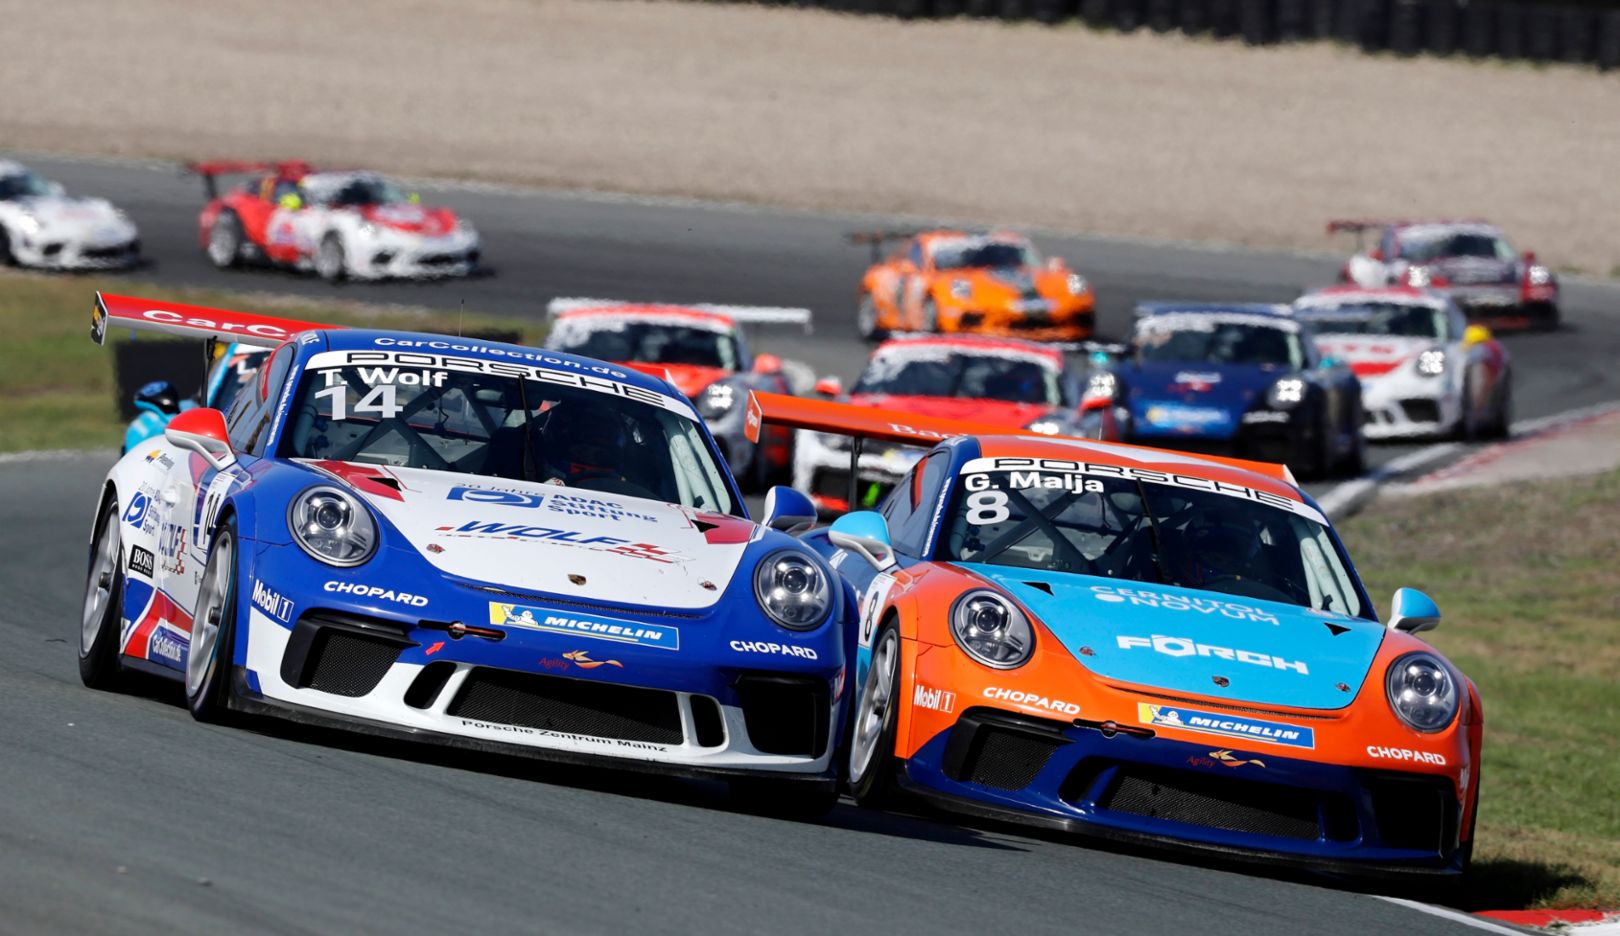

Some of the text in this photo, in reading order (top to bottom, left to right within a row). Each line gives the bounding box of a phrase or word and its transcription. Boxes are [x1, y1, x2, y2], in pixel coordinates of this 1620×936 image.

[143, 310, 296, 338] CarC
[374, 337, 627, 378] CarCollection.de
[316, 367, 448, 387] T. Wolf
[346, 351, 666, 406] PORSCHE
[314, 385, 403, 421] 14
[964, 471, 1104, 494] G. Malja
[994, 458, 1296, 510] PORSCHE
[547, 505, 621, 522] Sport
[550, 499, 659, 523] Stiftung
[553, 494, 623, 509] ADAC
[965, 490, 1009, 525] 8
[457, 520, 630, 545] WOLF
[132, 547, 153, 571] BOSS
[251, 579, 280, 616] Mobil
[323, 580, 429, 607] CHOPARD
[1090, 585, 1274, 617] CERNITOL
[864, 591, 880, 642] 8
[1129, 594, 1280, 626] NOVUM
[544, 615, 663, 641] MICHELIN
[730, 640, 818, 661] CHOPARD
[913, 683, 941, 711] Mobil
[983, 687, 1080, 715] CHOPARD
[462, 719, 668, 753] Porsche Zentrum Mainz
[1189, 716, 1300, 740] MICHELIN
[1367, 745, 1446, 766] CHOPARD
